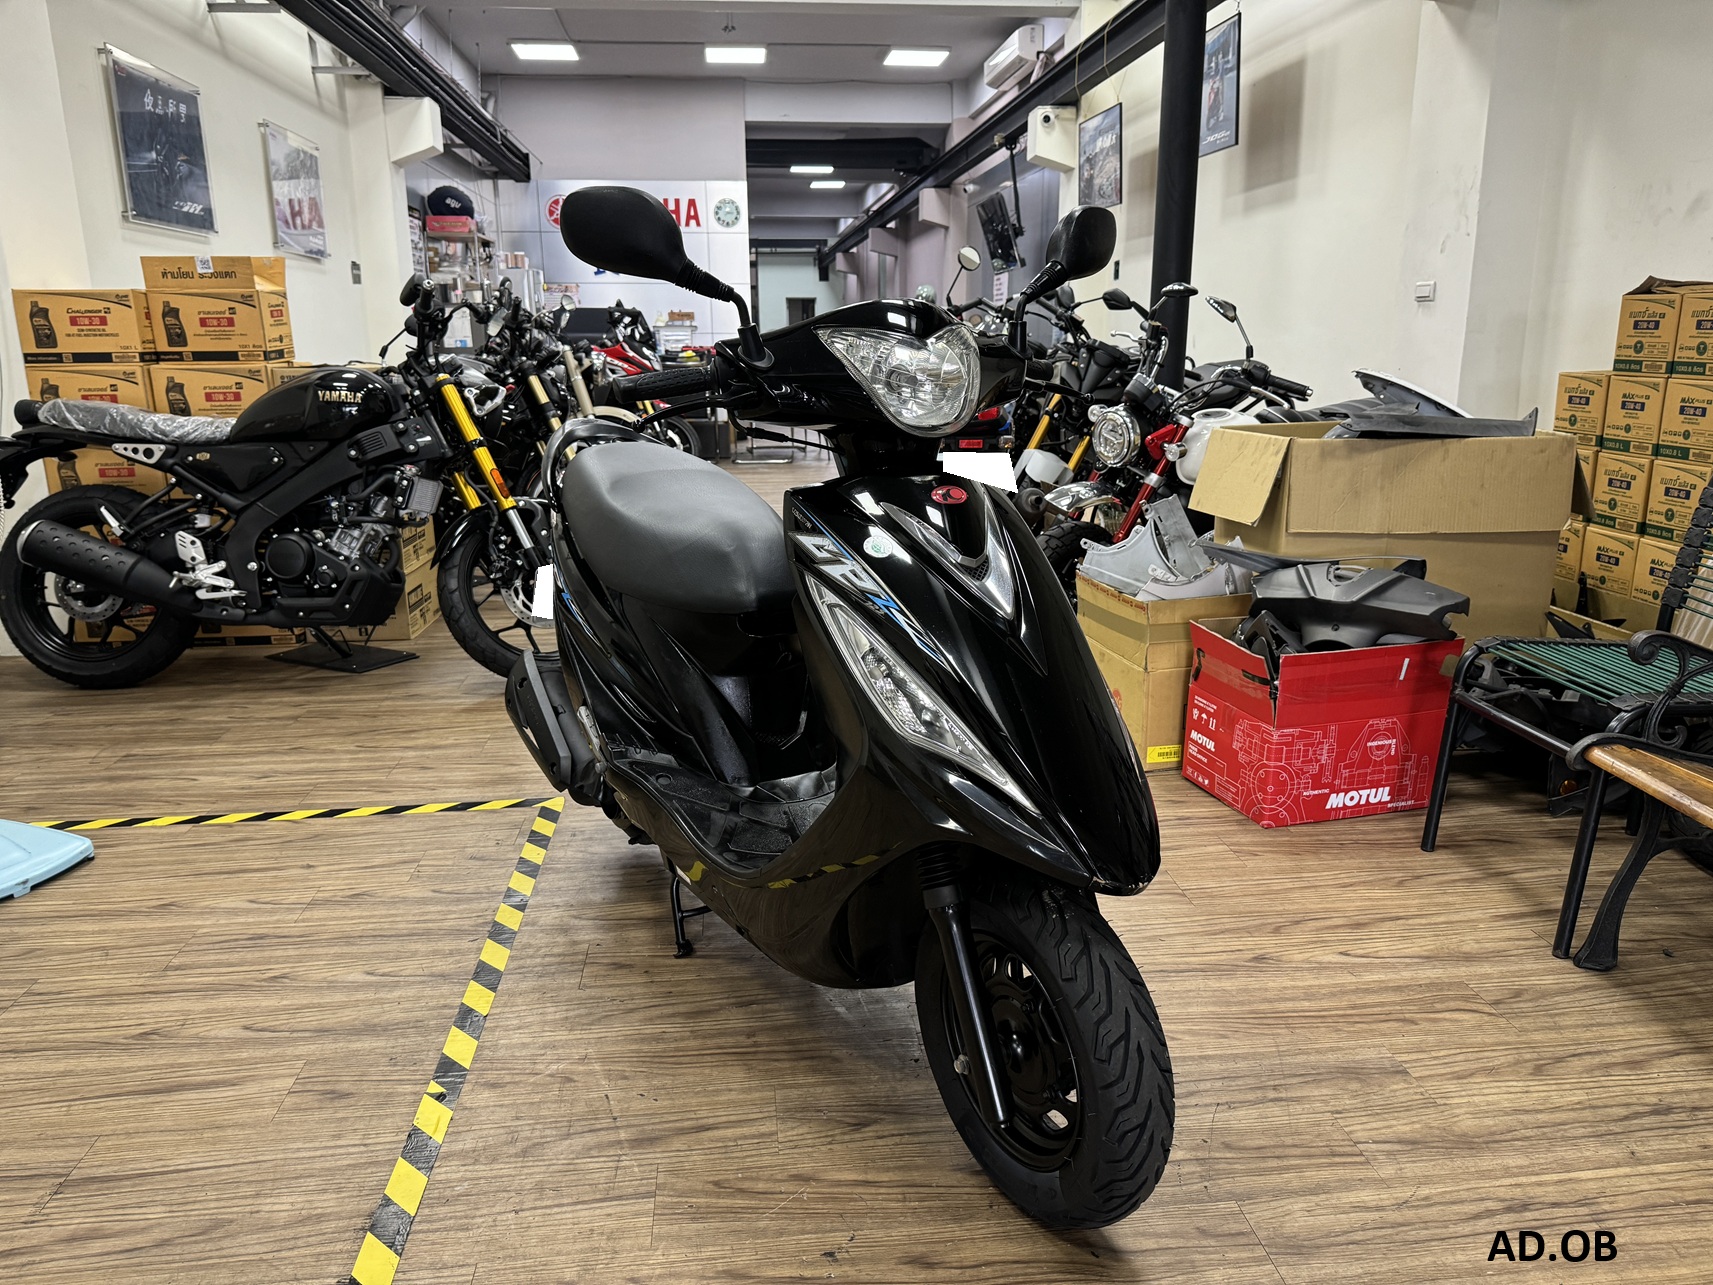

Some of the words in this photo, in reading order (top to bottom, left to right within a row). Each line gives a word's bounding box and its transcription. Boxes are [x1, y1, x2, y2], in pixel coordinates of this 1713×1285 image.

[317, 390, 362, 403] YAMAHA
[1190, 729, 1216, 751] MOTUL
[1302, 788, 1330, 796] AUTHENTIC
[1325, 786, 1391, 810] MOTUL
[1387, 800, 1415, 808] SPECIALIST
